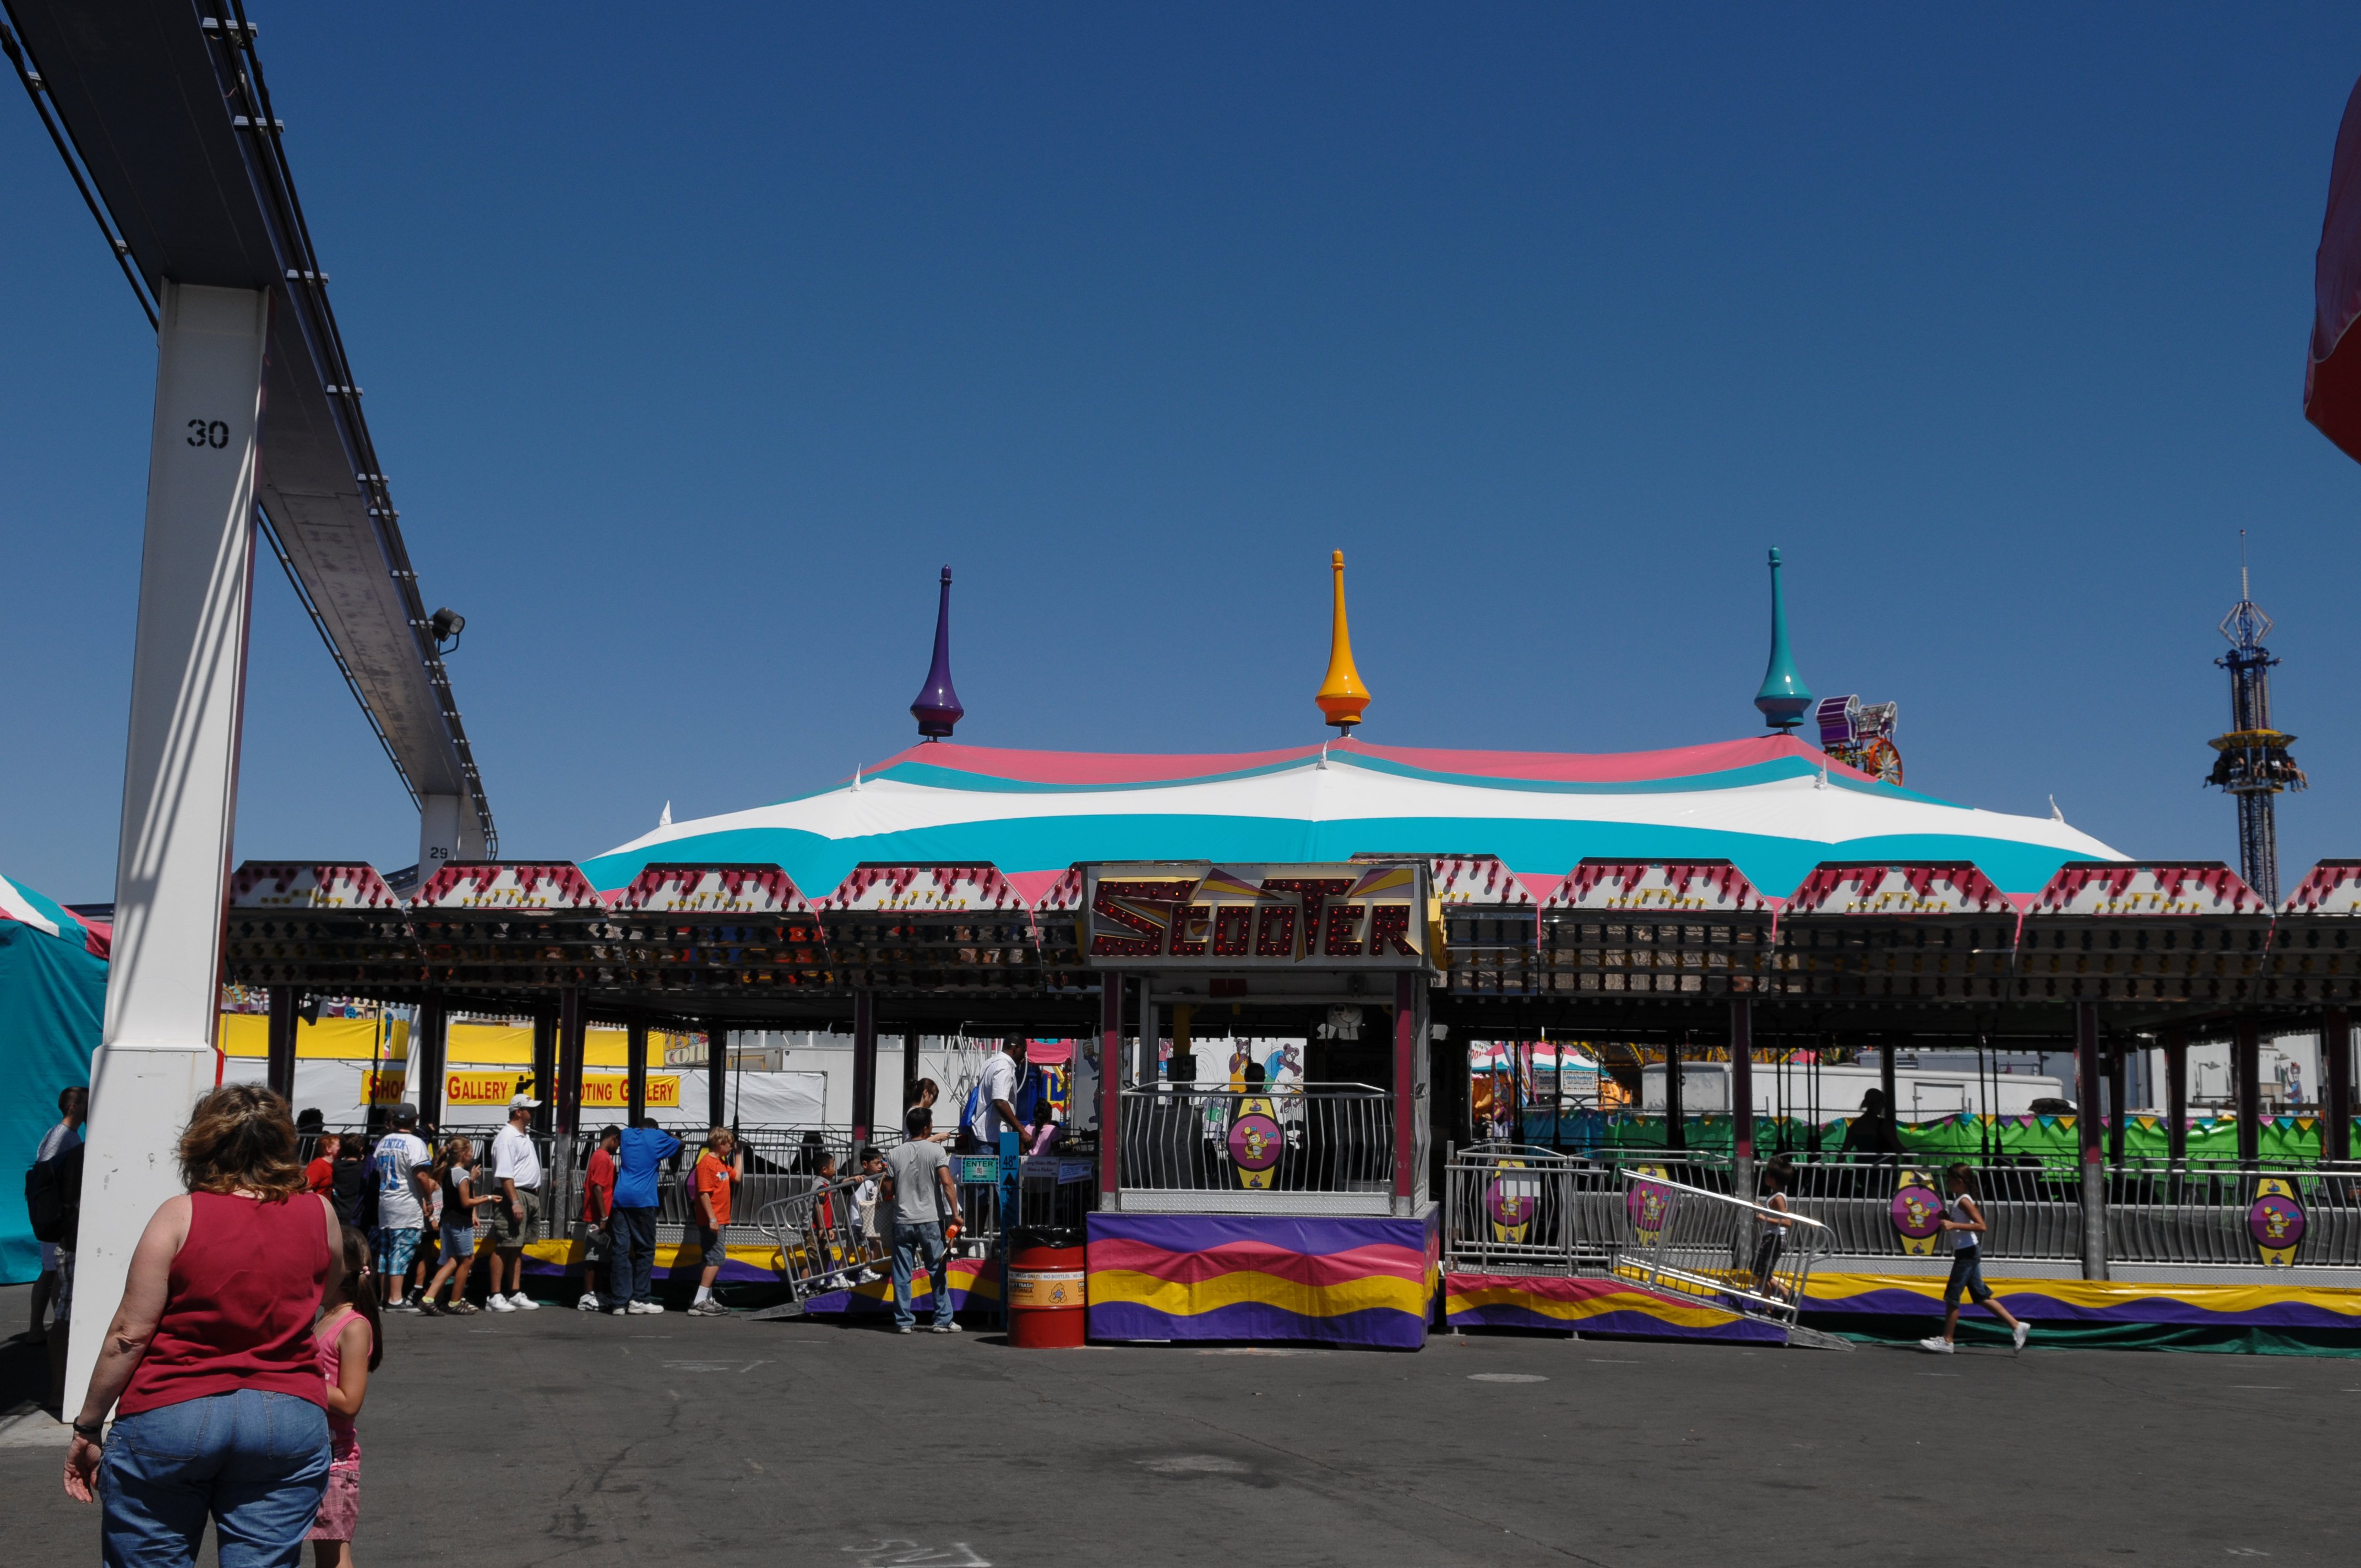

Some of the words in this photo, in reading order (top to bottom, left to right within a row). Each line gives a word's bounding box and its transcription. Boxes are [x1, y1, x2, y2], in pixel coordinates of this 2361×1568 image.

[187, 418, 229, 449] 30
[430, 847, 448, 859] 29
[1089, 876, 1422, 957] SCOOTER
[448, 1076, 508, 1100] GALLERY
[619, 1079, 674, 1101] GLERY
